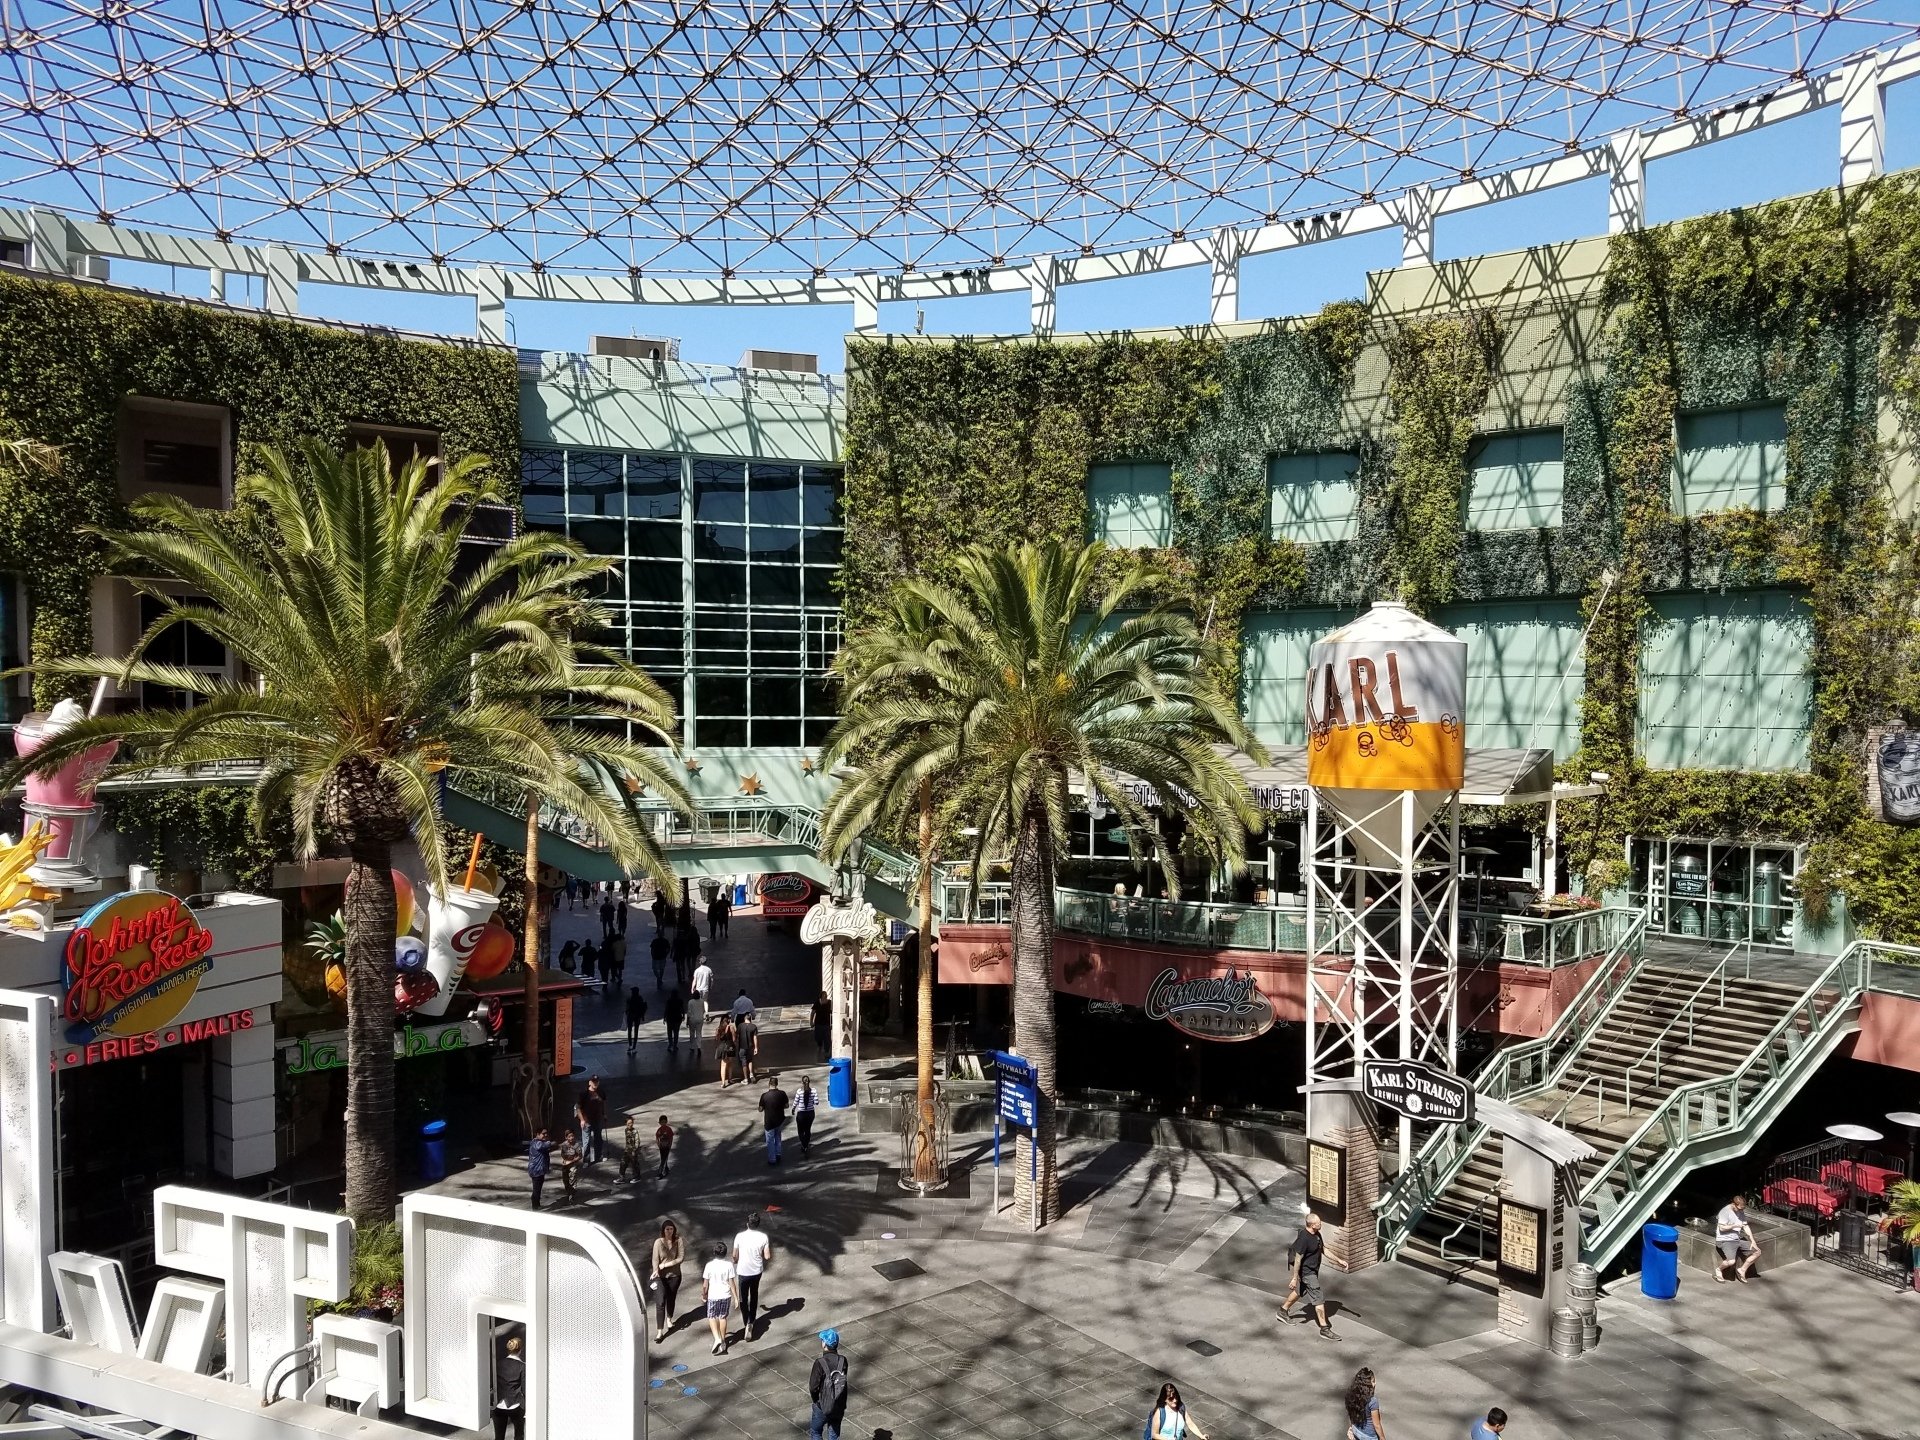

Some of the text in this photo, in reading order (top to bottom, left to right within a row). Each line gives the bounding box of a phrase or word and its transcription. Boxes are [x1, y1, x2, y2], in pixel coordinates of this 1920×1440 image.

[1305, 650, 1420, 736] KARL
[800, 898, 880, 945] Camacho's
[66, 897, 191, 1018] Johnny
[89, 927, 213, 1021] Rockets
[92, 961, 209, 1036] THE ORIGINAL HAMBURGER
[842, 941, 853, 1047] CANTINA
[1145, 966, 1265, 1020] Camacho's
[85, 1031, 160, 1066] FRIES
[181, 1010, 255, 1044] MALTS
[557, 1021, 566, 1068] FOOTWEAR
[1174, 1014, 1259, 1031] CANTINA
[288, 1025, 471, 1073] Jaba
[996, 1061, 1028, 1077] CITYWALK
[1368, 1068, 1463, 1108] KARL STRAUSS
[1373, 1088, 1457, 1117] BREWING COMPANY
[1552, 1226, 1564, 1237] A
[1552, 1242, 1563, 1272] HUG
